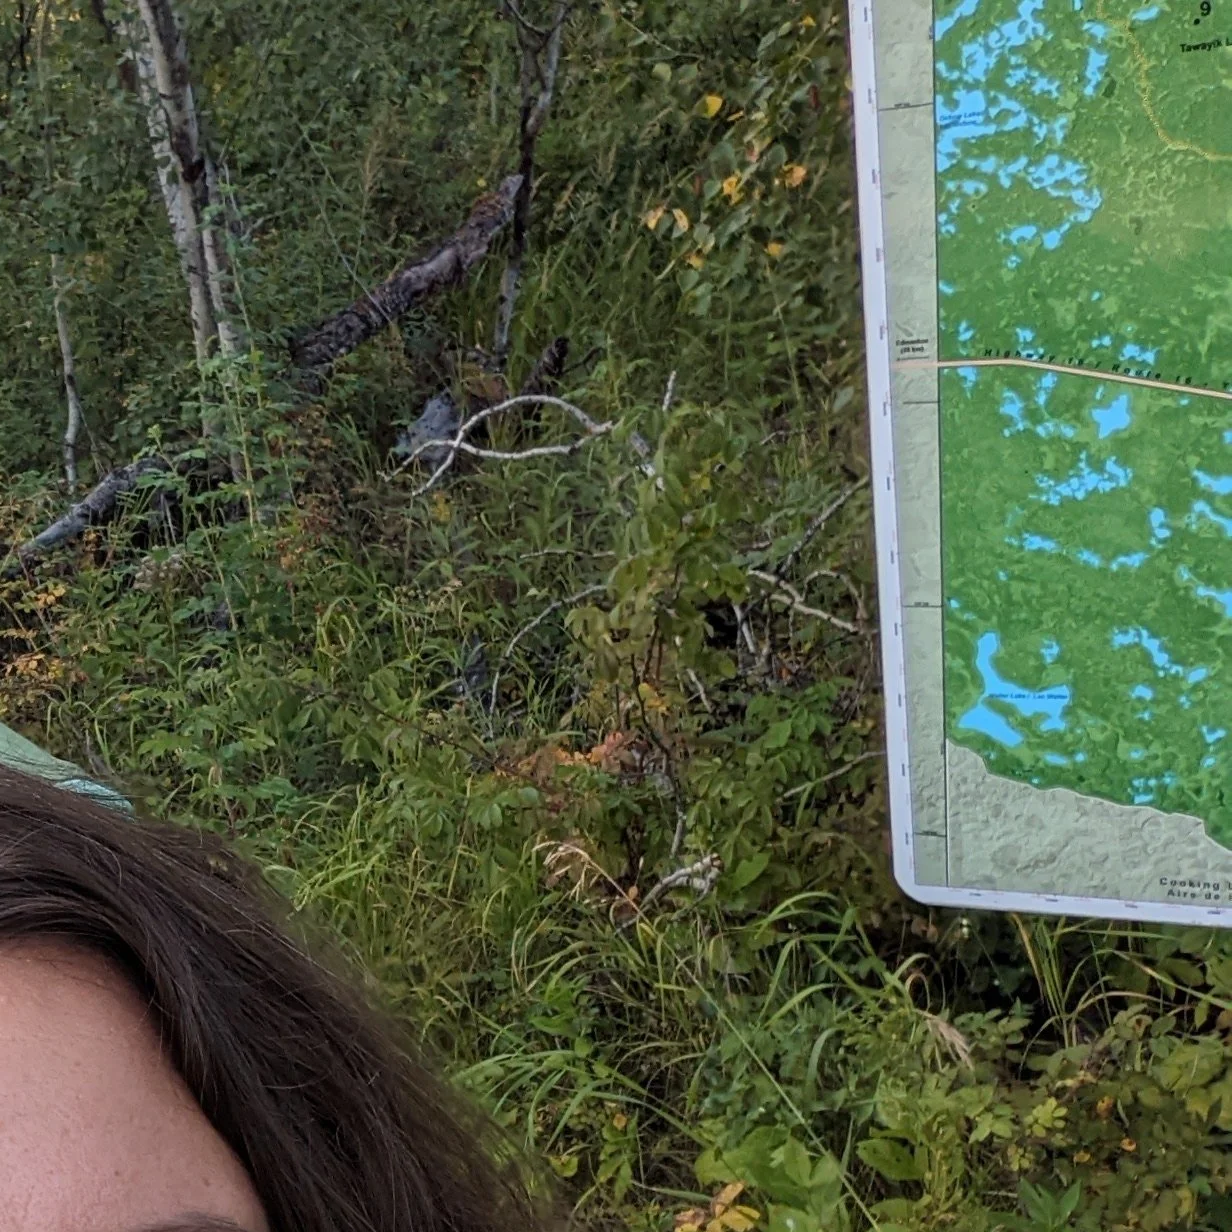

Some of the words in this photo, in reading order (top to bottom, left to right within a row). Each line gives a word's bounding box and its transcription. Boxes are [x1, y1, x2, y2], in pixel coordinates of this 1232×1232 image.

[1200, 1, 1211, 16] 9
[1180, 39, 1222, 52] Tawayik
[1159, 877, 1220, 891] Cooking
[1167, 889, 1196, 899] Aire
